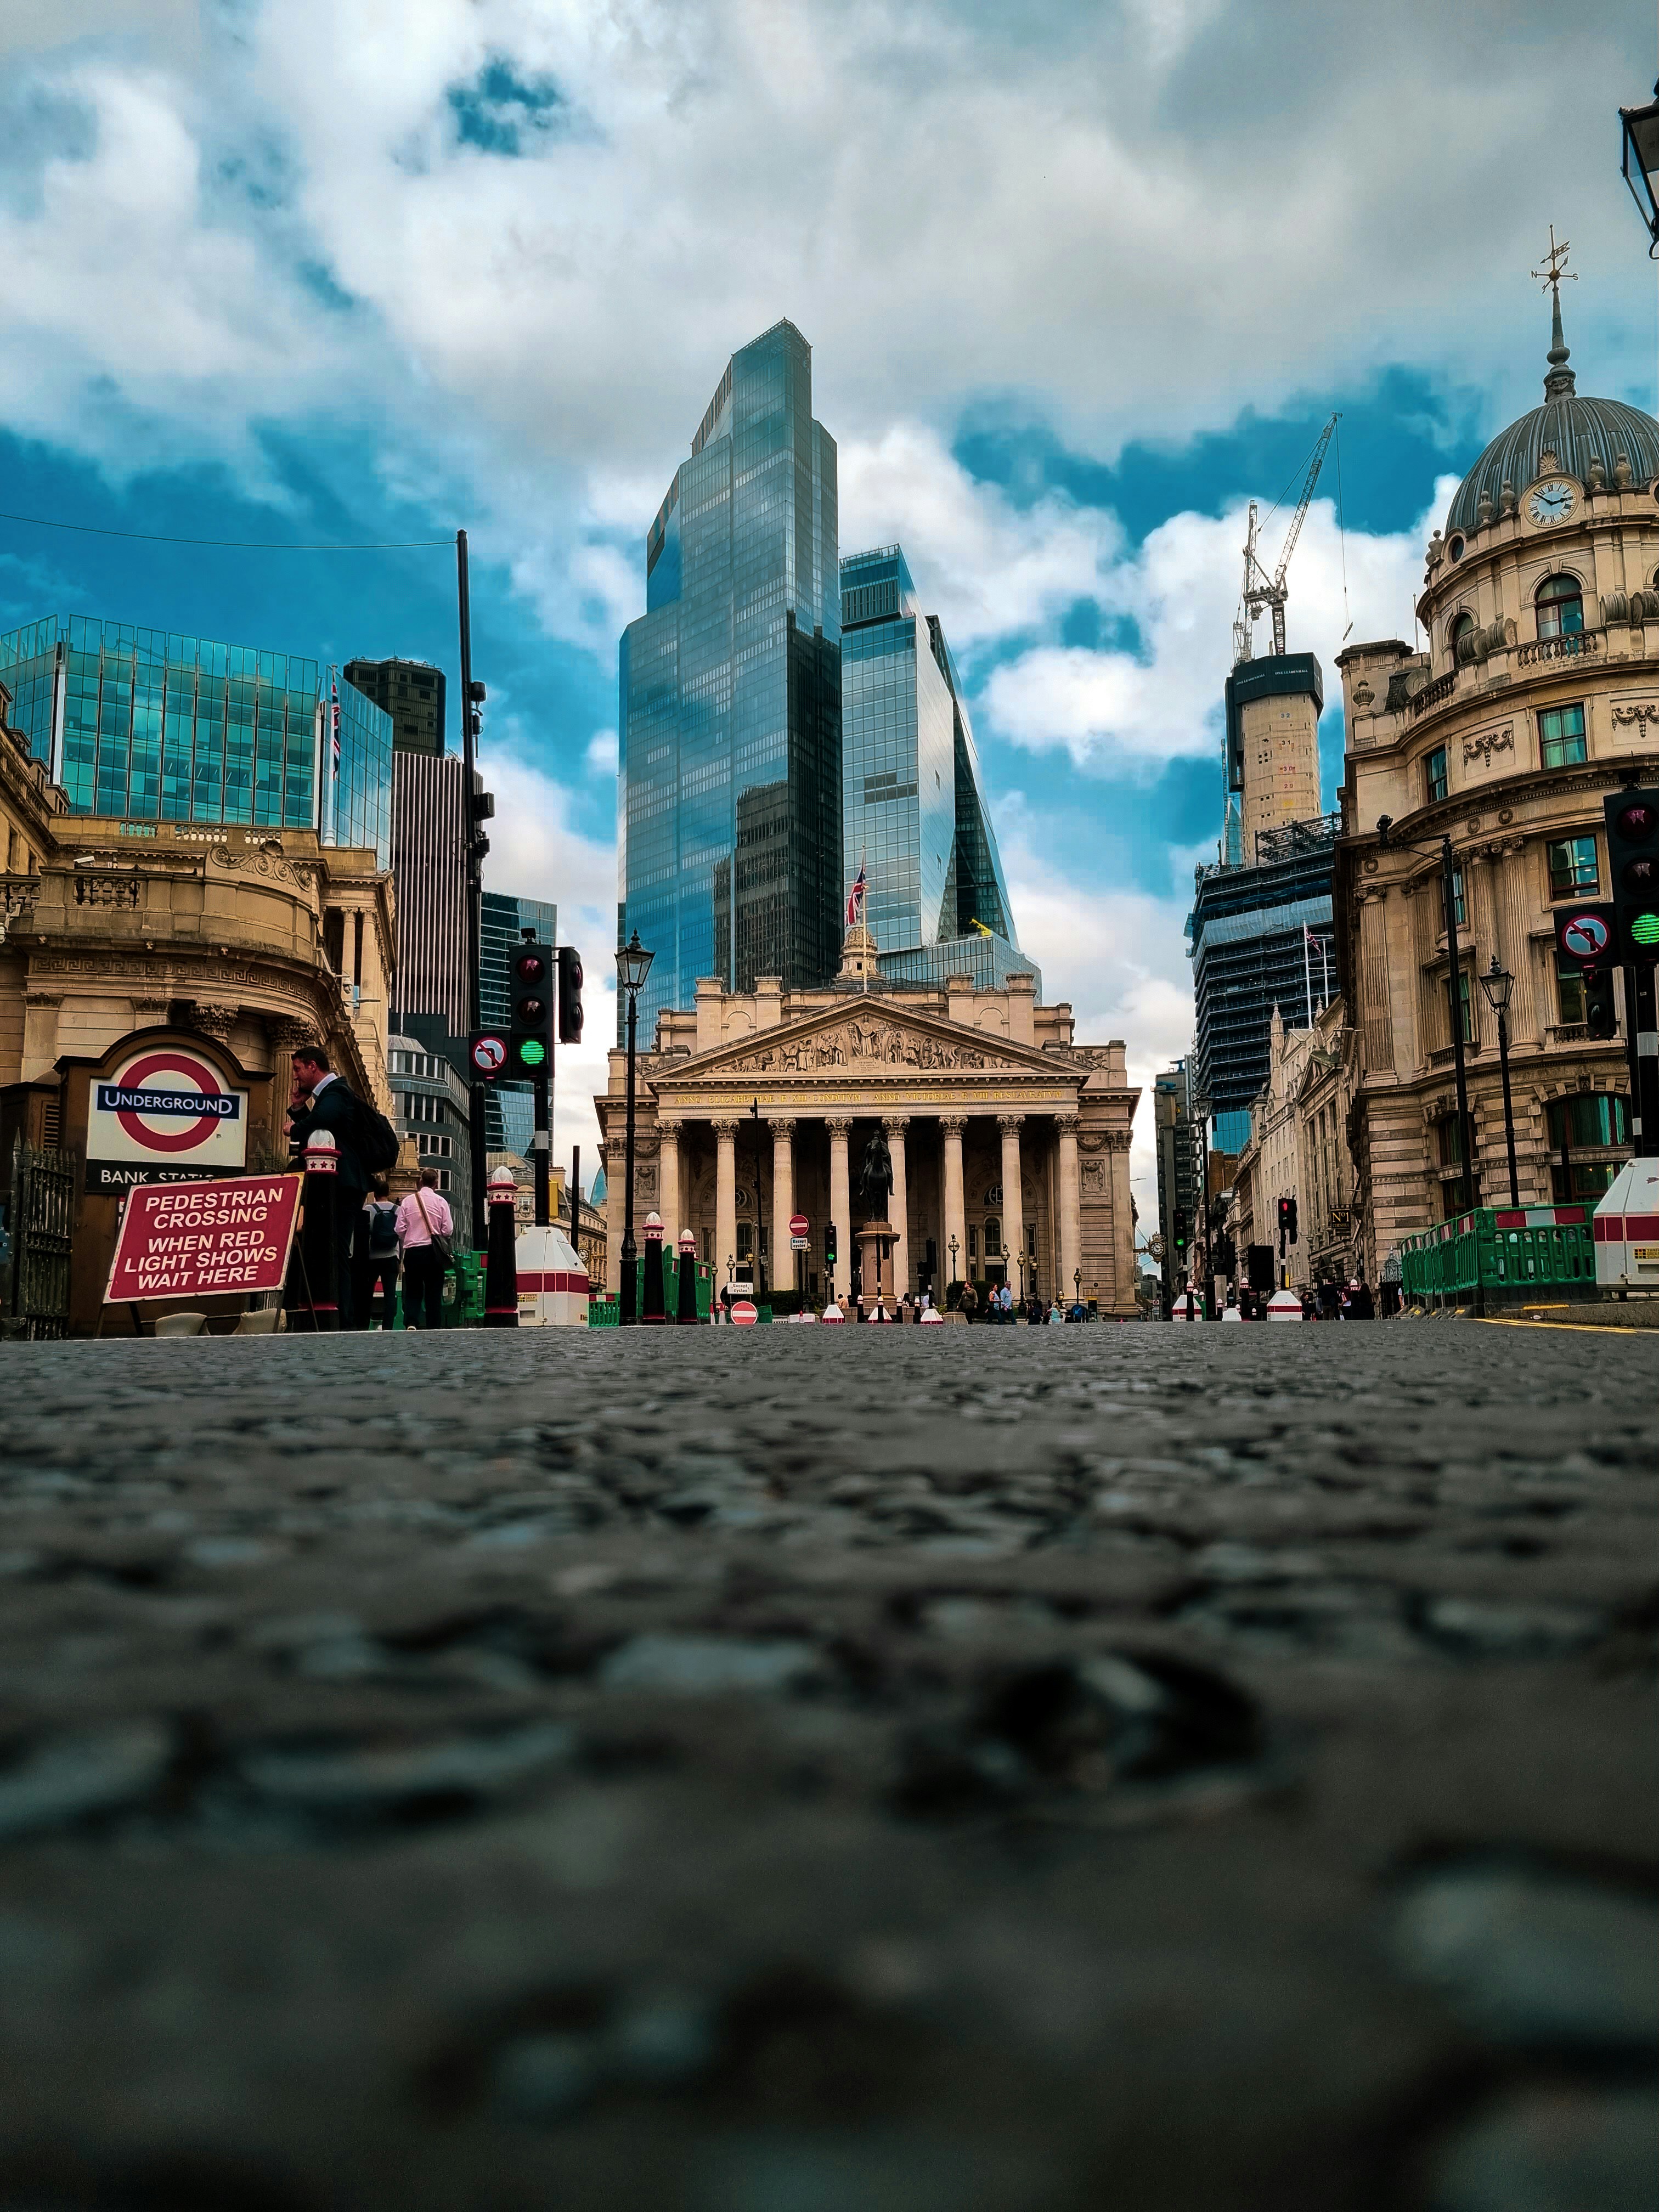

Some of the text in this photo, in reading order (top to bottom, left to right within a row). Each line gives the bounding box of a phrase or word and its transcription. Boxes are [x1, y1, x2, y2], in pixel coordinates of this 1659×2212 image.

[104, 1090, 233, 1114] UNDERGROUND
[873, 1093, 900, 1101] ANNO
[101, 1170, 149, 1183] BANK
[145, 1187, 284, 1212] PEDESTRIAN
[154, 1206, 268, 1229] CROSSING
[148, 1230, 265, 1254] WHEN RED
[125, 1246, 278, 1273] LIGHT SHOWS
[138, 1265, 259, 1290] WAIT HERE
